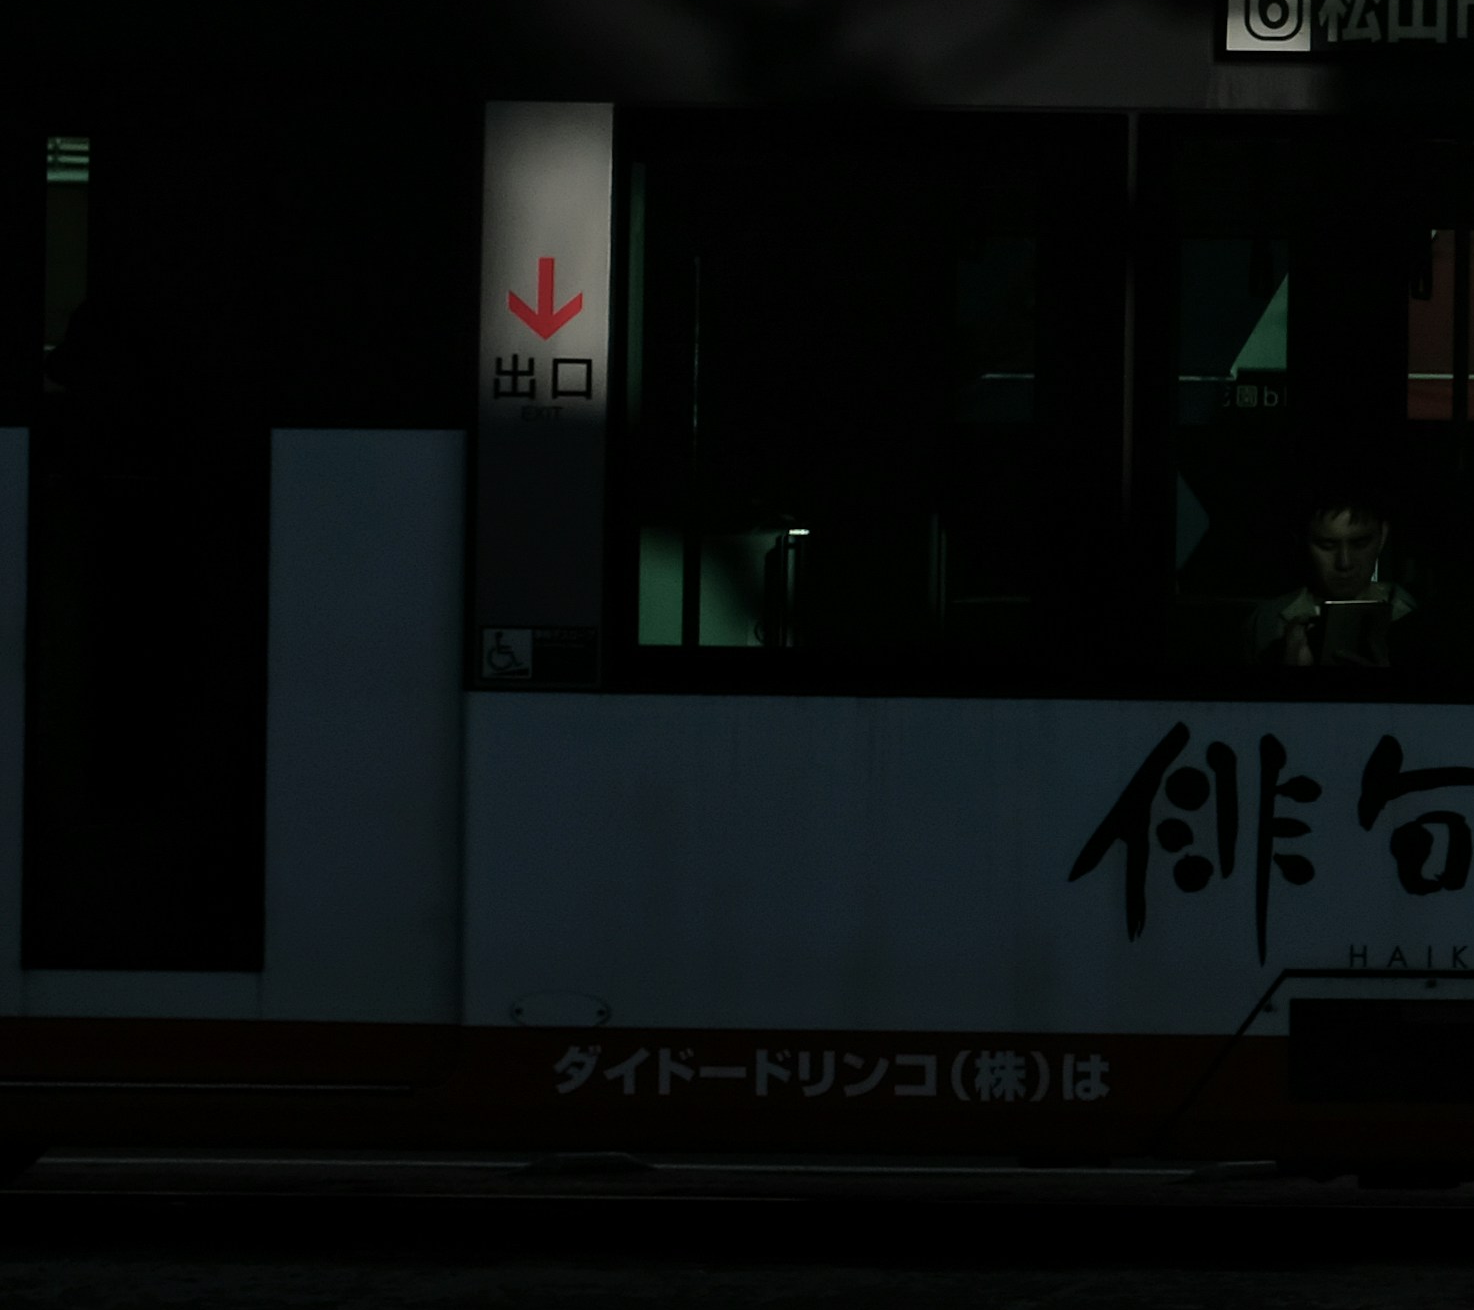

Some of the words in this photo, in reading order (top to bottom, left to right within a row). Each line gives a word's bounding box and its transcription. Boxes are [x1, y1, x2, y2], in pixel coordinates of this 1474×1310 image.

[493, 353, 592, 400] 出口
[521, 404, 563, 422] EXIT
[552, 1043, 1111, 1104] ダイドードリンコ(株)は
